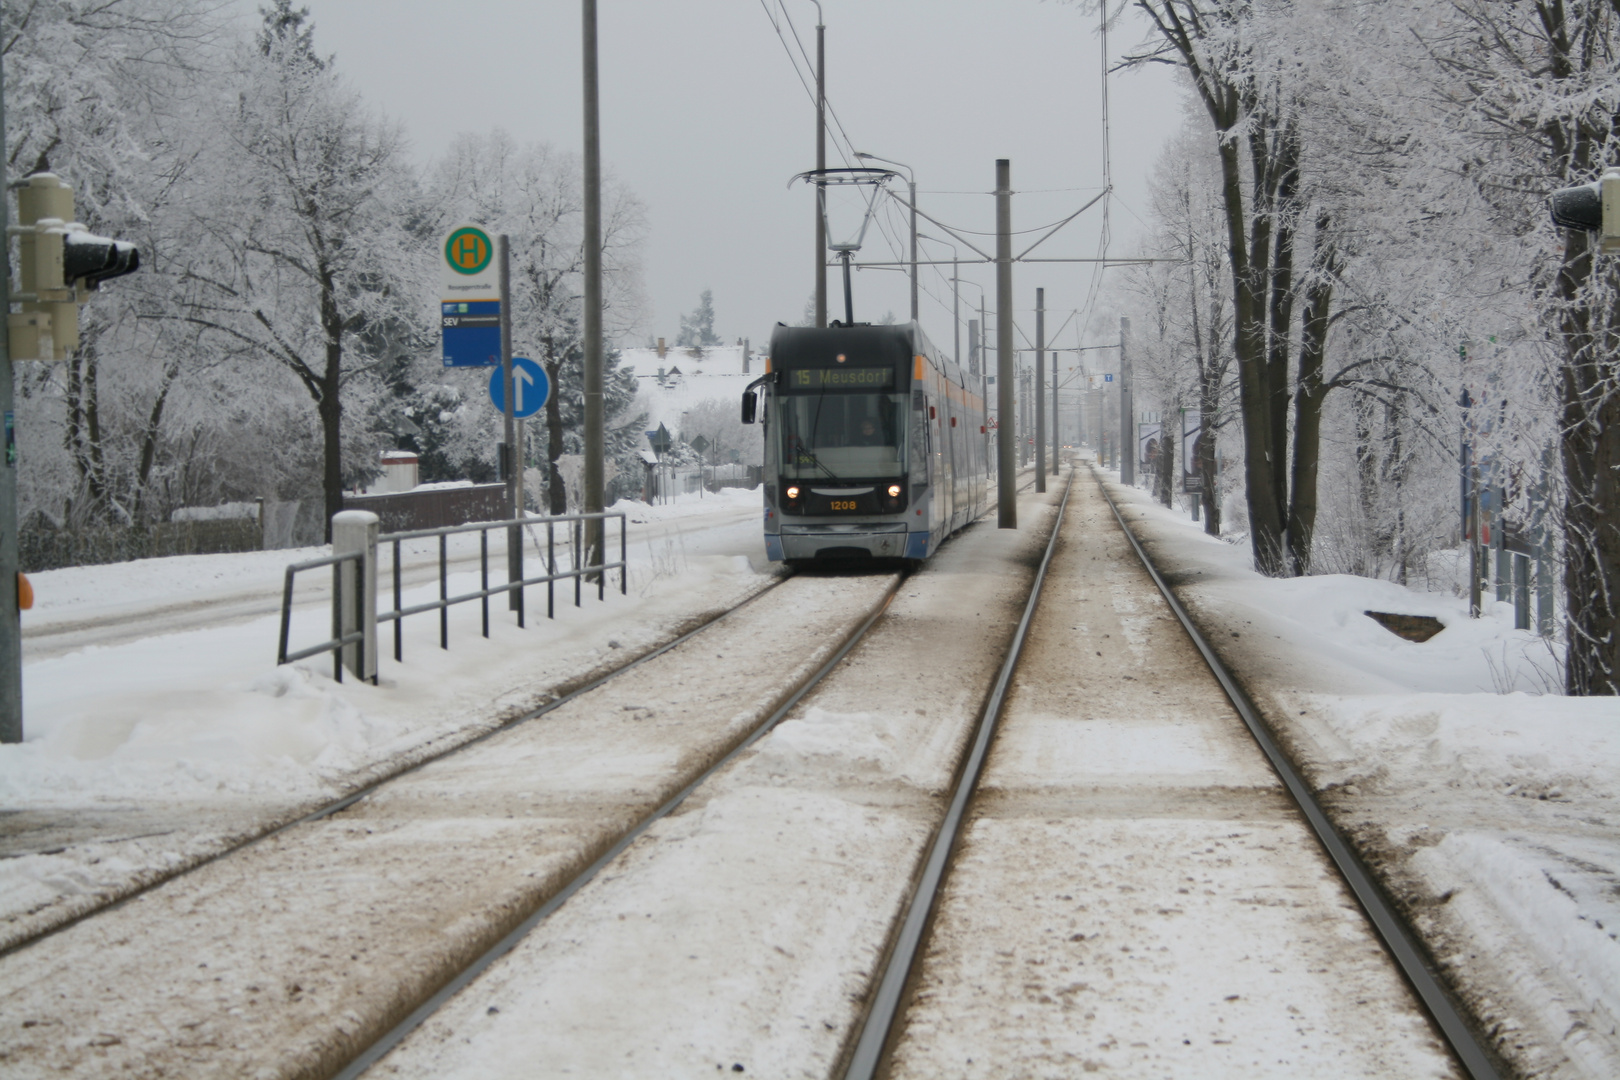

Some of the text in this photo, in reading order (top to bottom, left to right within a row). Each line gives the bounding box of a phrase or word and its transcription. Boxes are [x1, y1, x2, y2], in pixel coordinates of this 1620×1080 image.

[459, 238, 479, 264] H
[443, 317, 459, 326] SEV
[796, 368, 888, 385] 15 Meusdorf
[830, 501, 857, 511] 1208
